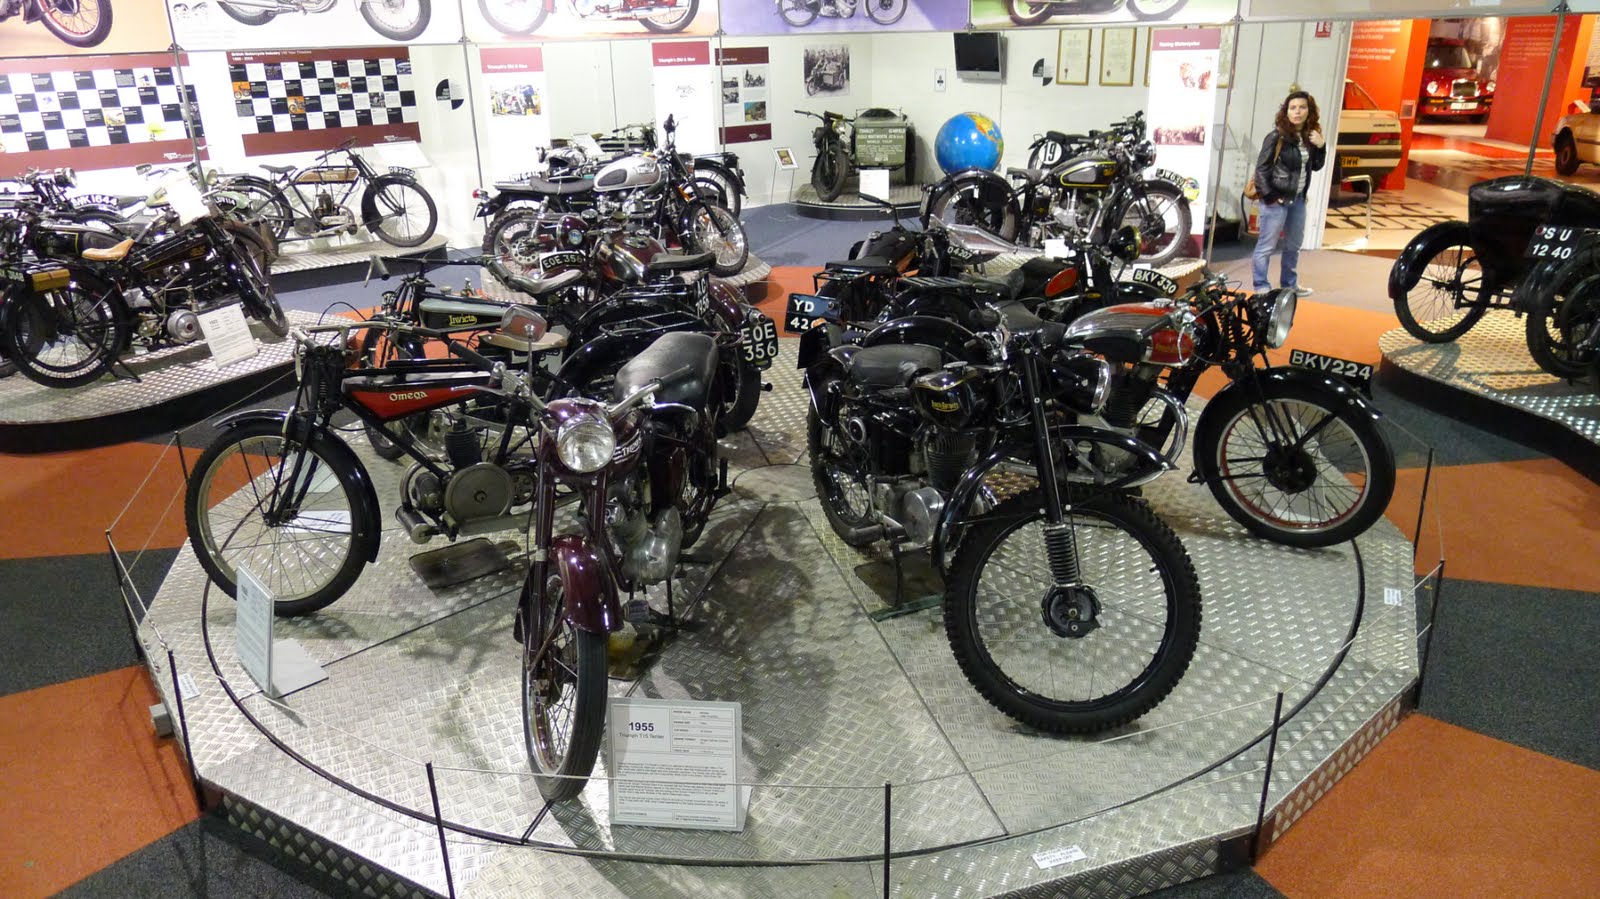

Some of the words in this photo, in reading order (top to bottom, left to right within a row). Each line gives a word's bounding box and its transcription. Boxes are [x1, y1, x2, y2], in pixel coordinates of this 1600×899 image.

[1044, 142, 1056, 162] 19
[543, 255, 563, 268] EOE
[794, 299, 815, 313] YD
[449, 314, 477, 325] Invicta
[741, 322, 775, 344] EOE
[743, 341, 777, 361] 356
[1292, 350, 1371, 380] BKV224
[389, 391, 428, 401] Omega
[629, 721, 655, 732] 1955
